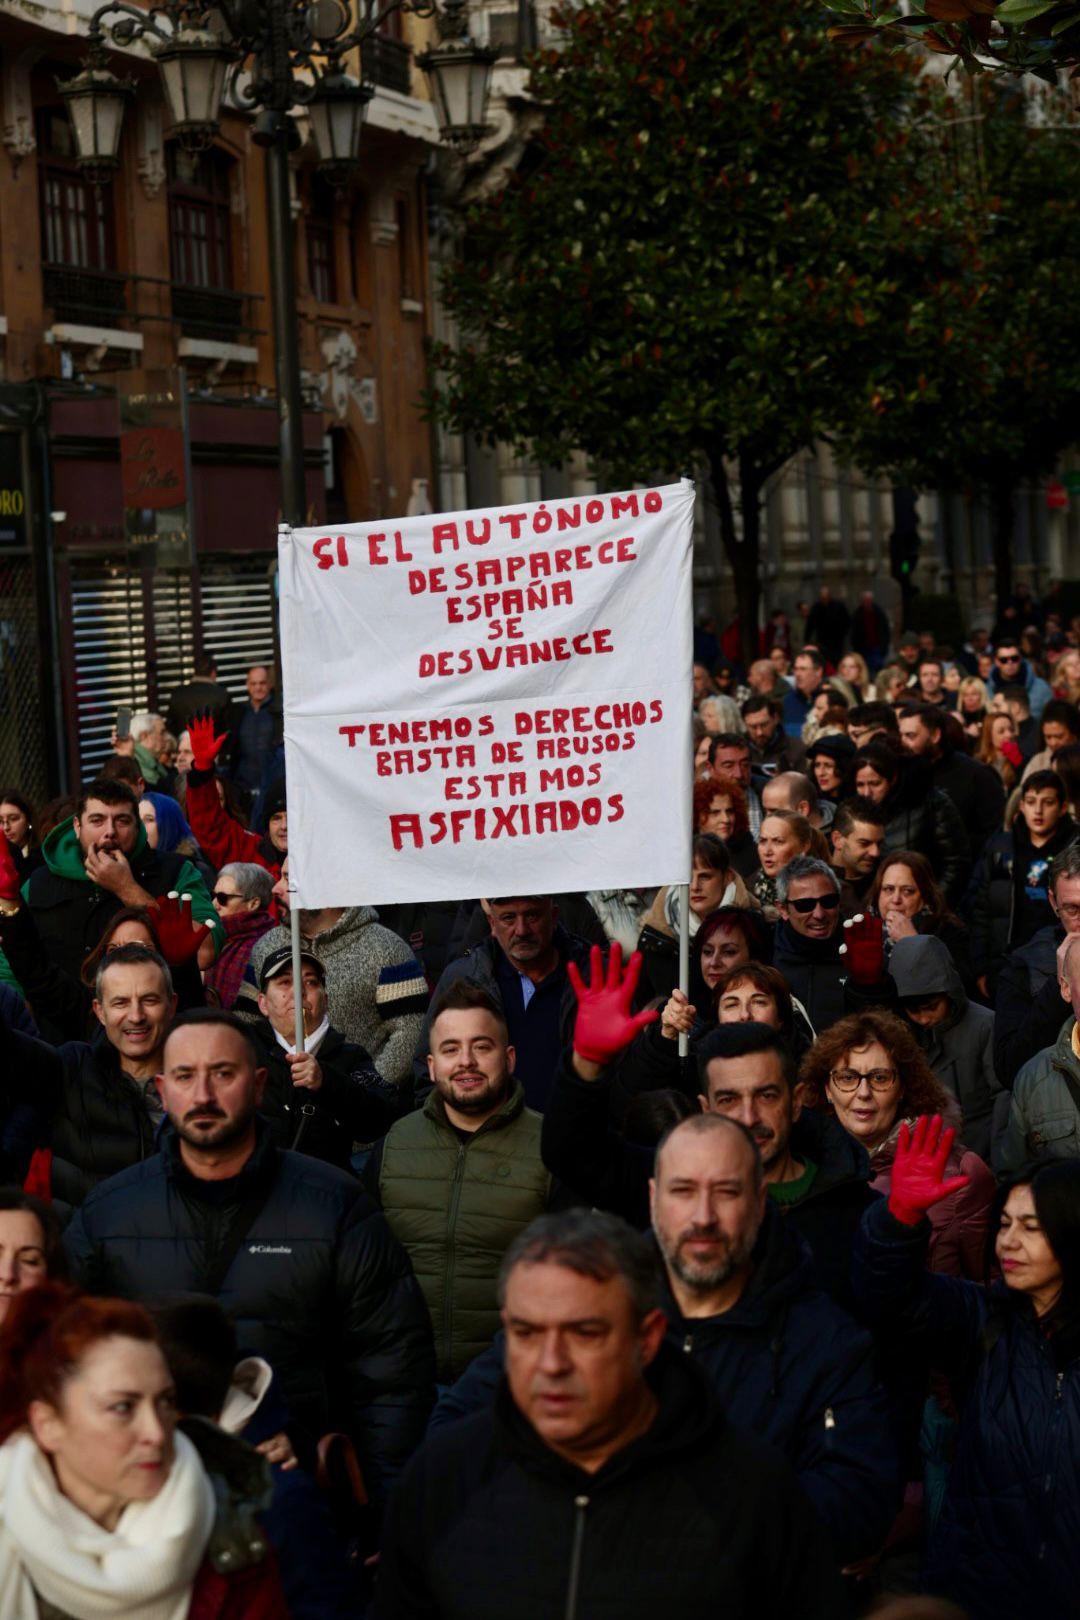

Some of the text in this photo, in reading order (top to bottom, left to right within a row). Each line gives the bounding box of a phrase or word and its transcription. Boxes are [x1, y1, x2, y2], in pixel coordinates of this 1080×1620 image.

[0, 488, 24, 516] RO
[313, 491, 663, 570] SI EL AUTÓNOMO
[408, 536, 637, 595] DESAPARECE
[447, 579, 573, 624] ESPAÑA
[488, 617, 526, 640] SE
[419, 629, 614, 677] DESVANECE
[339, 700, 663, 747] TENEMOS DERECHOS
[376, 732, 635, 776] BASTA DE ABUSOS
[389, 793, 624, 851] ASFIXIADOS
[257, 1245, 292, 1254] Columbia
